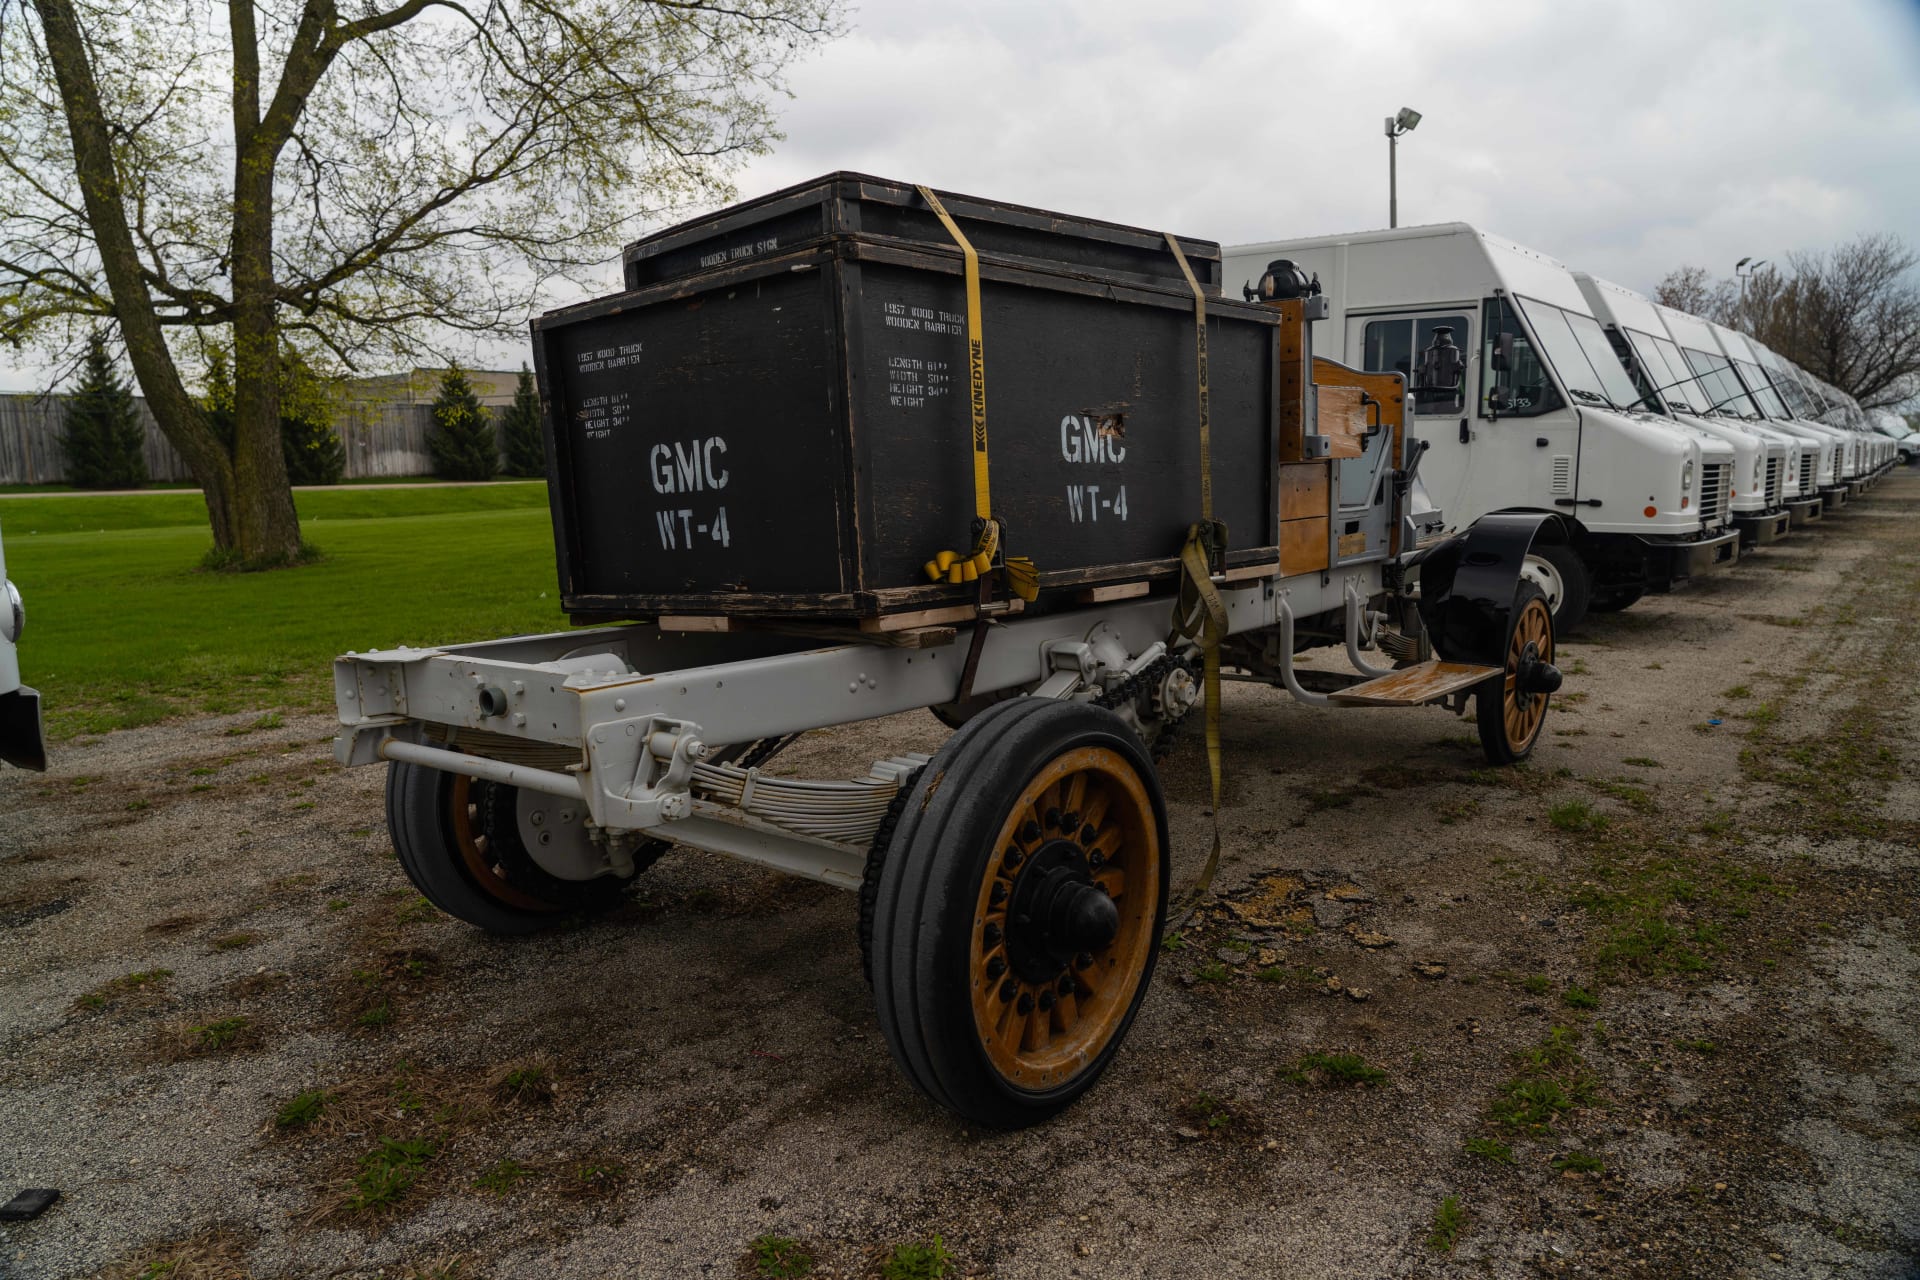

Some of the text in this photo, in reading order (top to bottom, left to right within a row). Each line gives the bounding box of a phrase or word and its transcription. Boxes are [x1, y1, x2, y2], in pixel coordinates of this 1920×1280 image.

[884, 302, 965, 325] 1957 WOOD TRUCK
[885, 316, 962, 336] WOODEN BARRIER
[620, 343, 643, 356] TRUCK
[888, 357, 923, 370] LENGTH
[889, 370, 918, 382] WIDTH
[971, 338, 984, 418] KINEDYNE
[889, 383, 924, 395] HEIGHT
[890, 395, 925, 408] WEIGHT
[585, 408, 605, 418] IDTH
[1061, 415, 1126, 464] GMC
[650, 436, 729, 494] GMC
[1066, 485, 1128, 523] WT-4
[656, 506, 730, 551] WT-4
